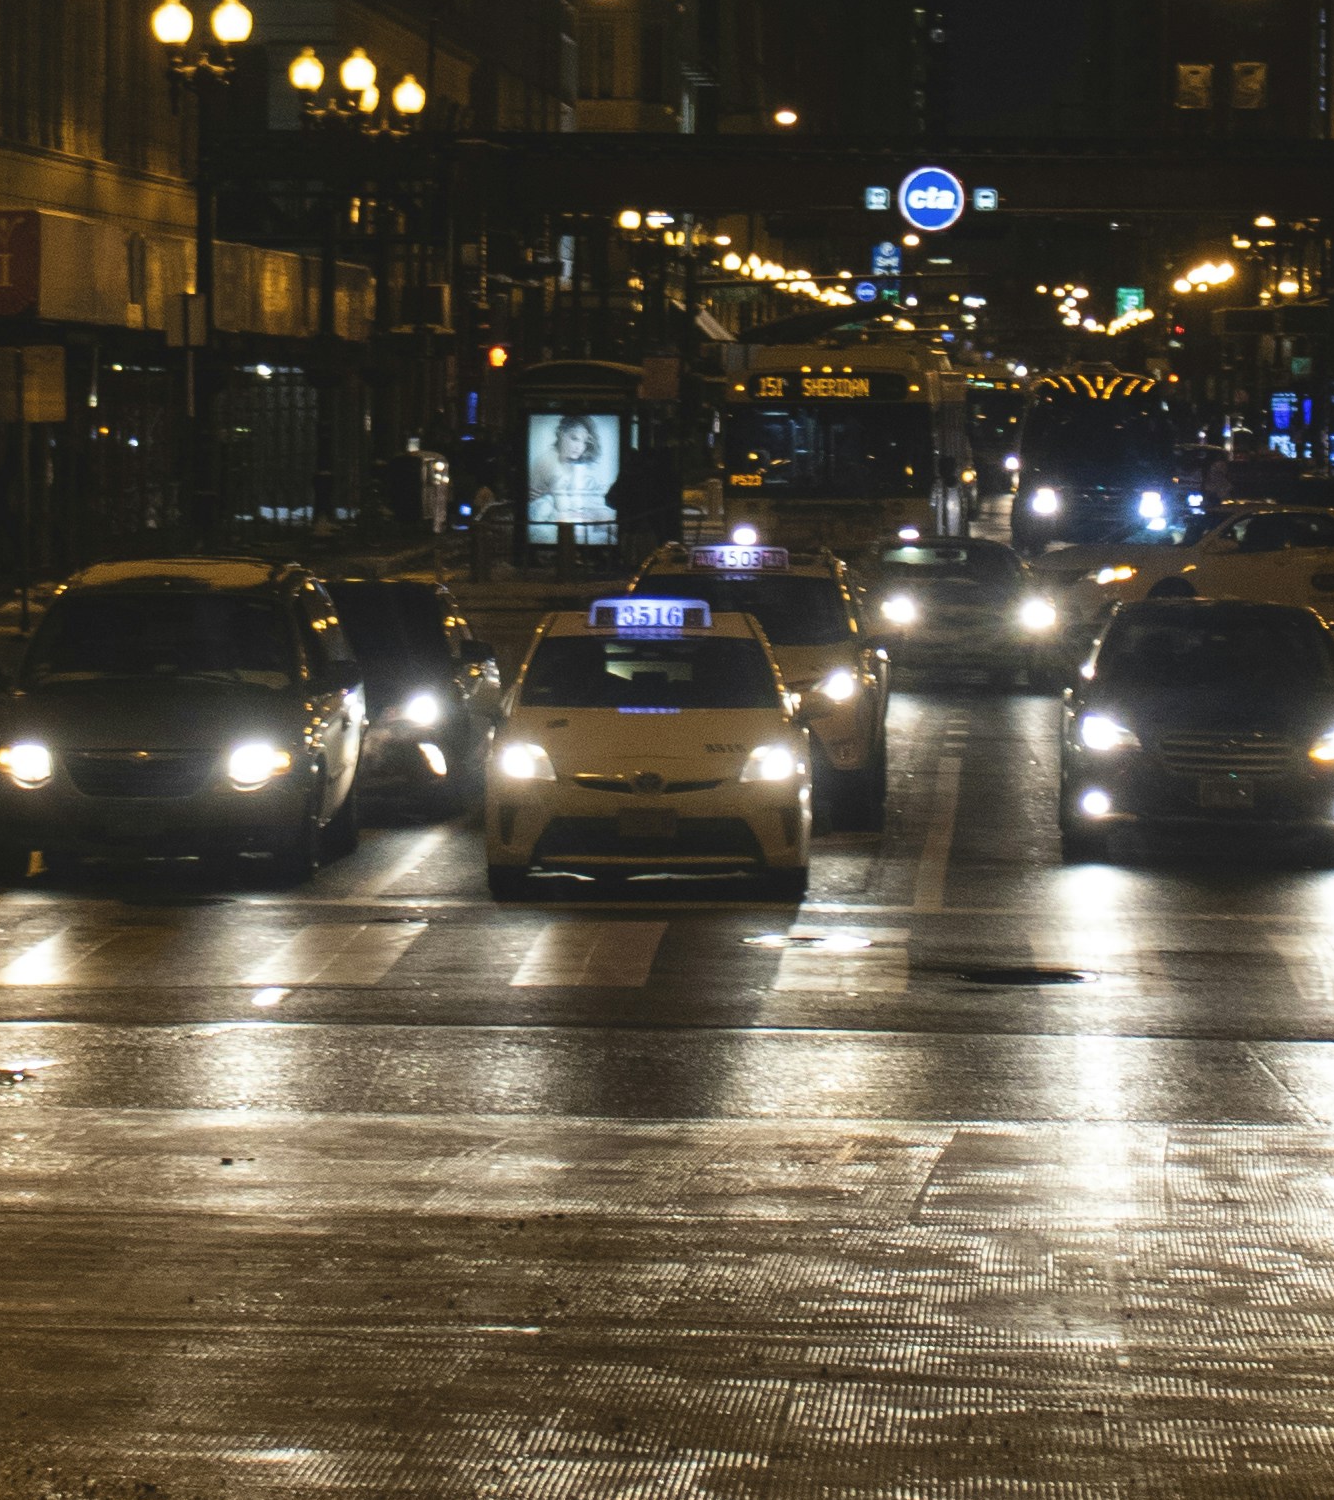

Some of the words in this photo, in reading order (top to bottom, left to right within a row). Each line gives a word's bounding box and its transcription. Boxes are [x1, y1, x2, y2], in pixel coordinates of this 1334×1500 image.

[908, 186, 955, 210] cta
[757, 376, 784, 397] 151
[801, 377, 870, 397] SHERIDAN
[717, 550, 762, 567] 4503
[622, 605, 683, 626] 3516
